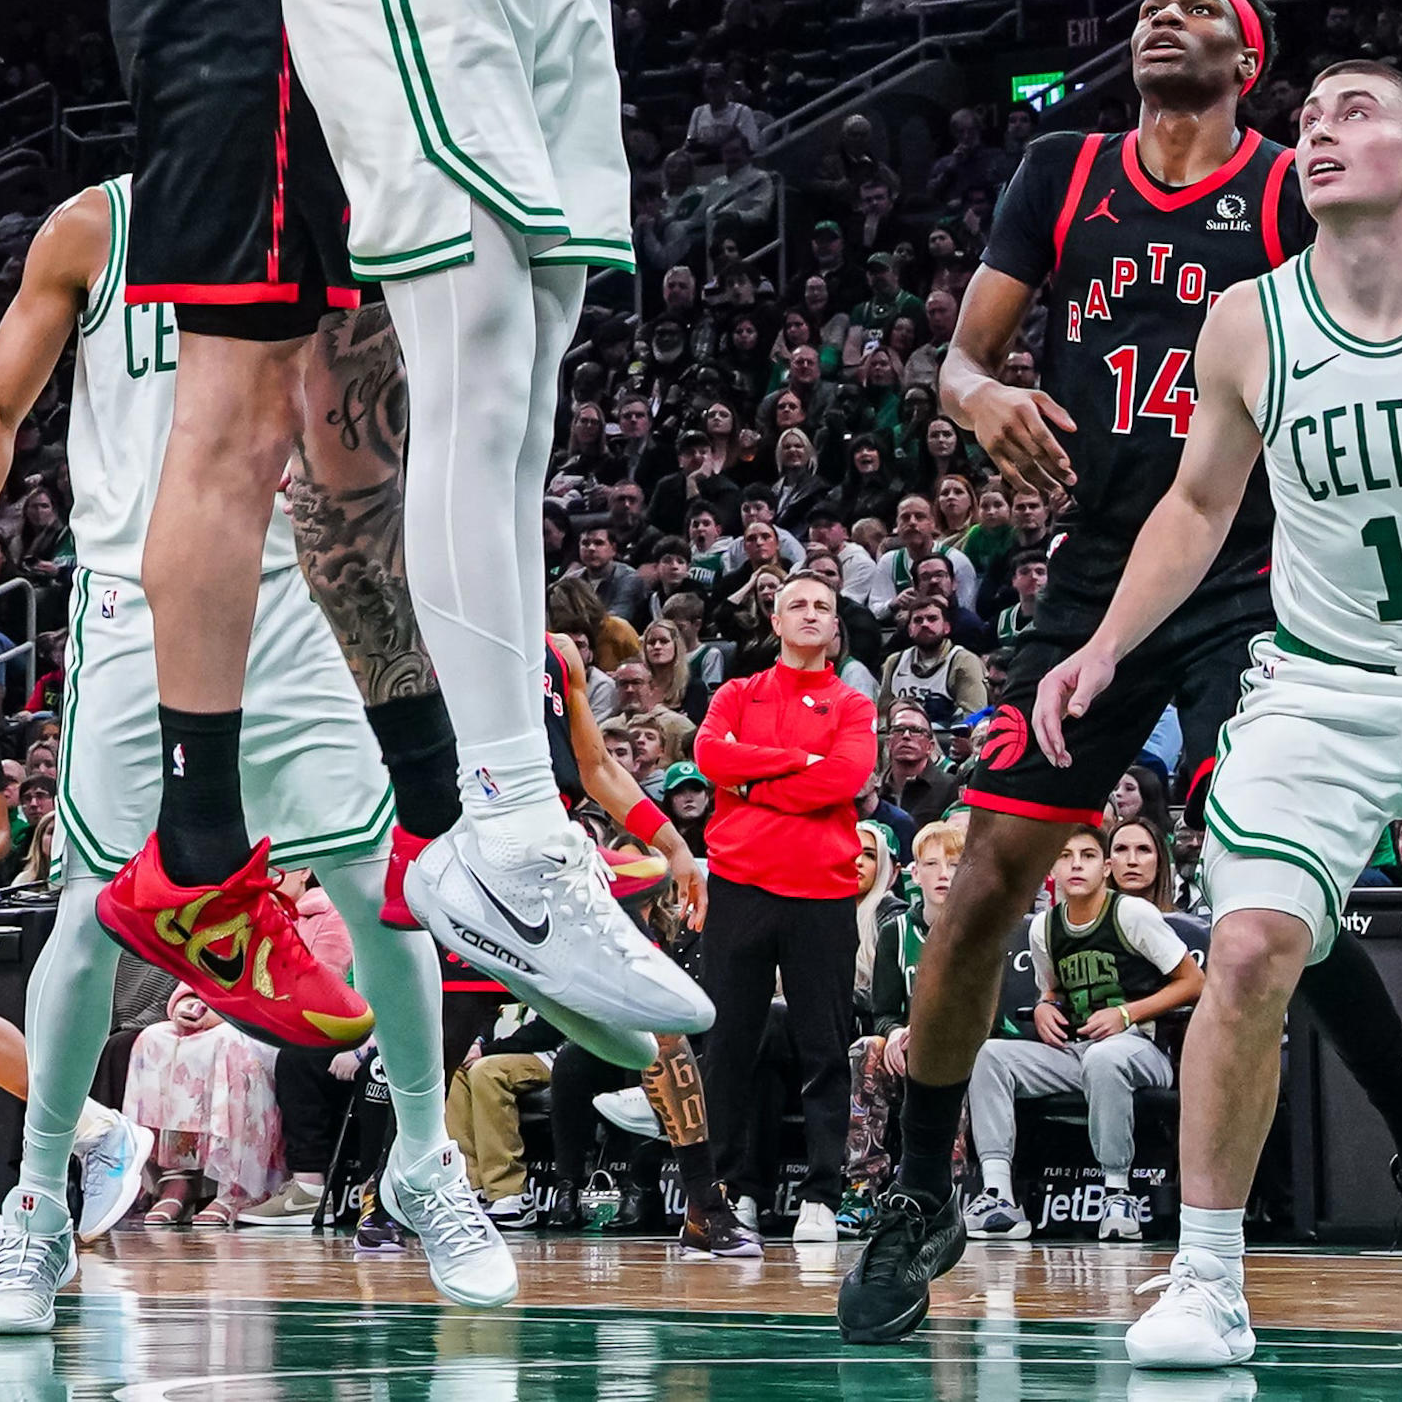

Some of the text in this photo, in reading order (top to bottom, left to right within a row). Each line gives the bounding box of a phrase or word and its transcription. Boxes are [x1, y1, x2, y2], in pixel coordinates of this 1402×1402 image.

[1067, 18, 1099, 46] EXIT
[1206, 218, 1252, 233] Sun Life
[1067, 243, 1220, 343] RAPTO
[125, 302, 175, 379] CE
[1105, 344, 1198, 438] 14
[1059, 950, 1118, 986] CELTICS
[365, 1083, 389, 1098] NIK
